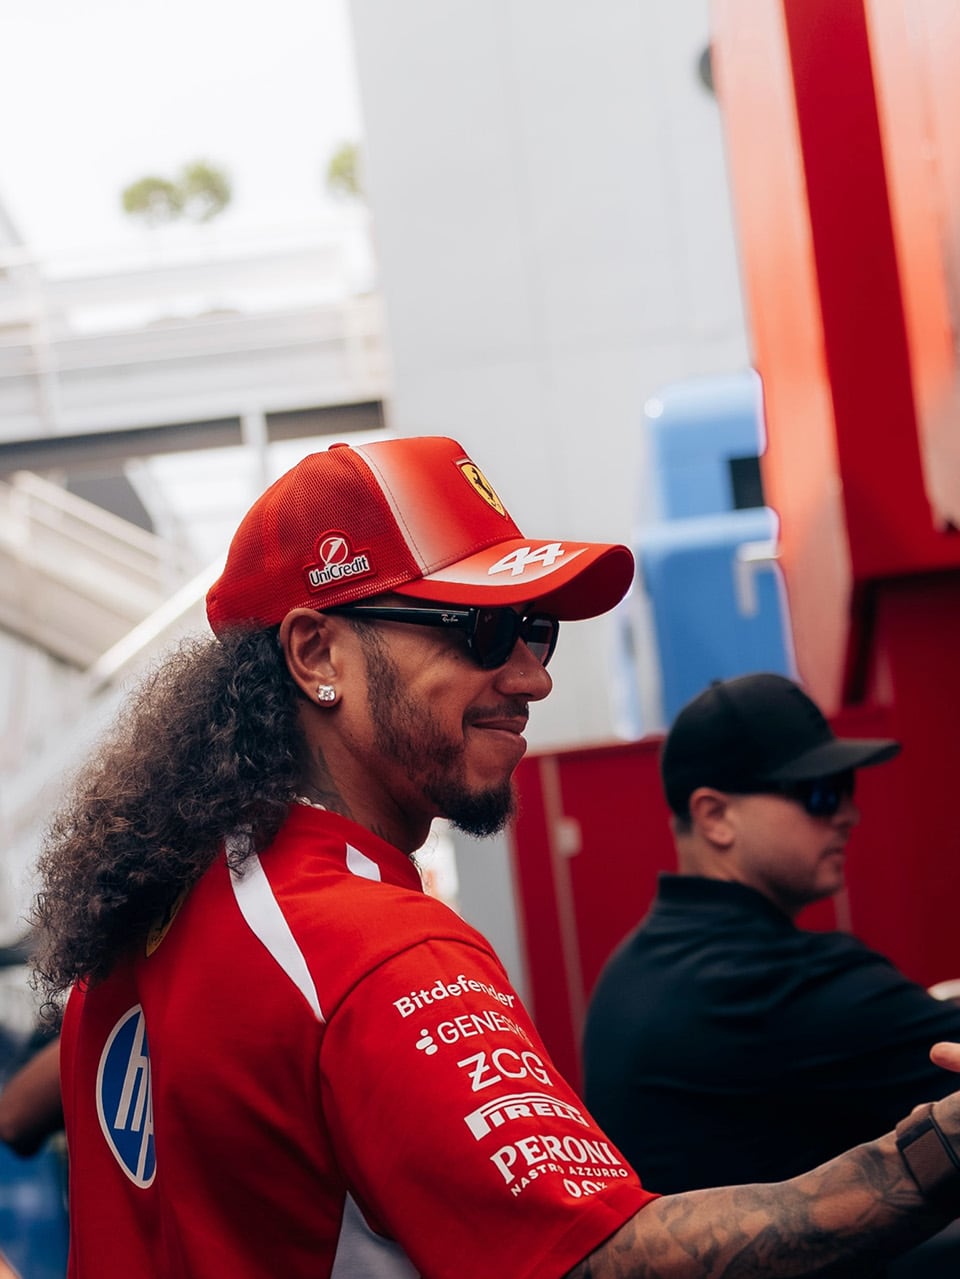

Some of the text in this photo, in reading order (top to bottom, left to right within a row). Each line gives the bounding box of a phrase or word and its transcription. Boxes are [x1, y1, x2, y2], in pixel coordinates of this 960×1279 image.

[308, 555, 369, 587] UniCredit
[487, 542, 565, 577] 44
[393, 975, 515, 1018] Bitdefender
[457, 1048, 554, 1093] ZCG
[463, 1092, 591, 1141] PIRELLI
[489, 1135, 623, 1185] PERONI
[568, 1166, 629, 1178] AZZURRO
